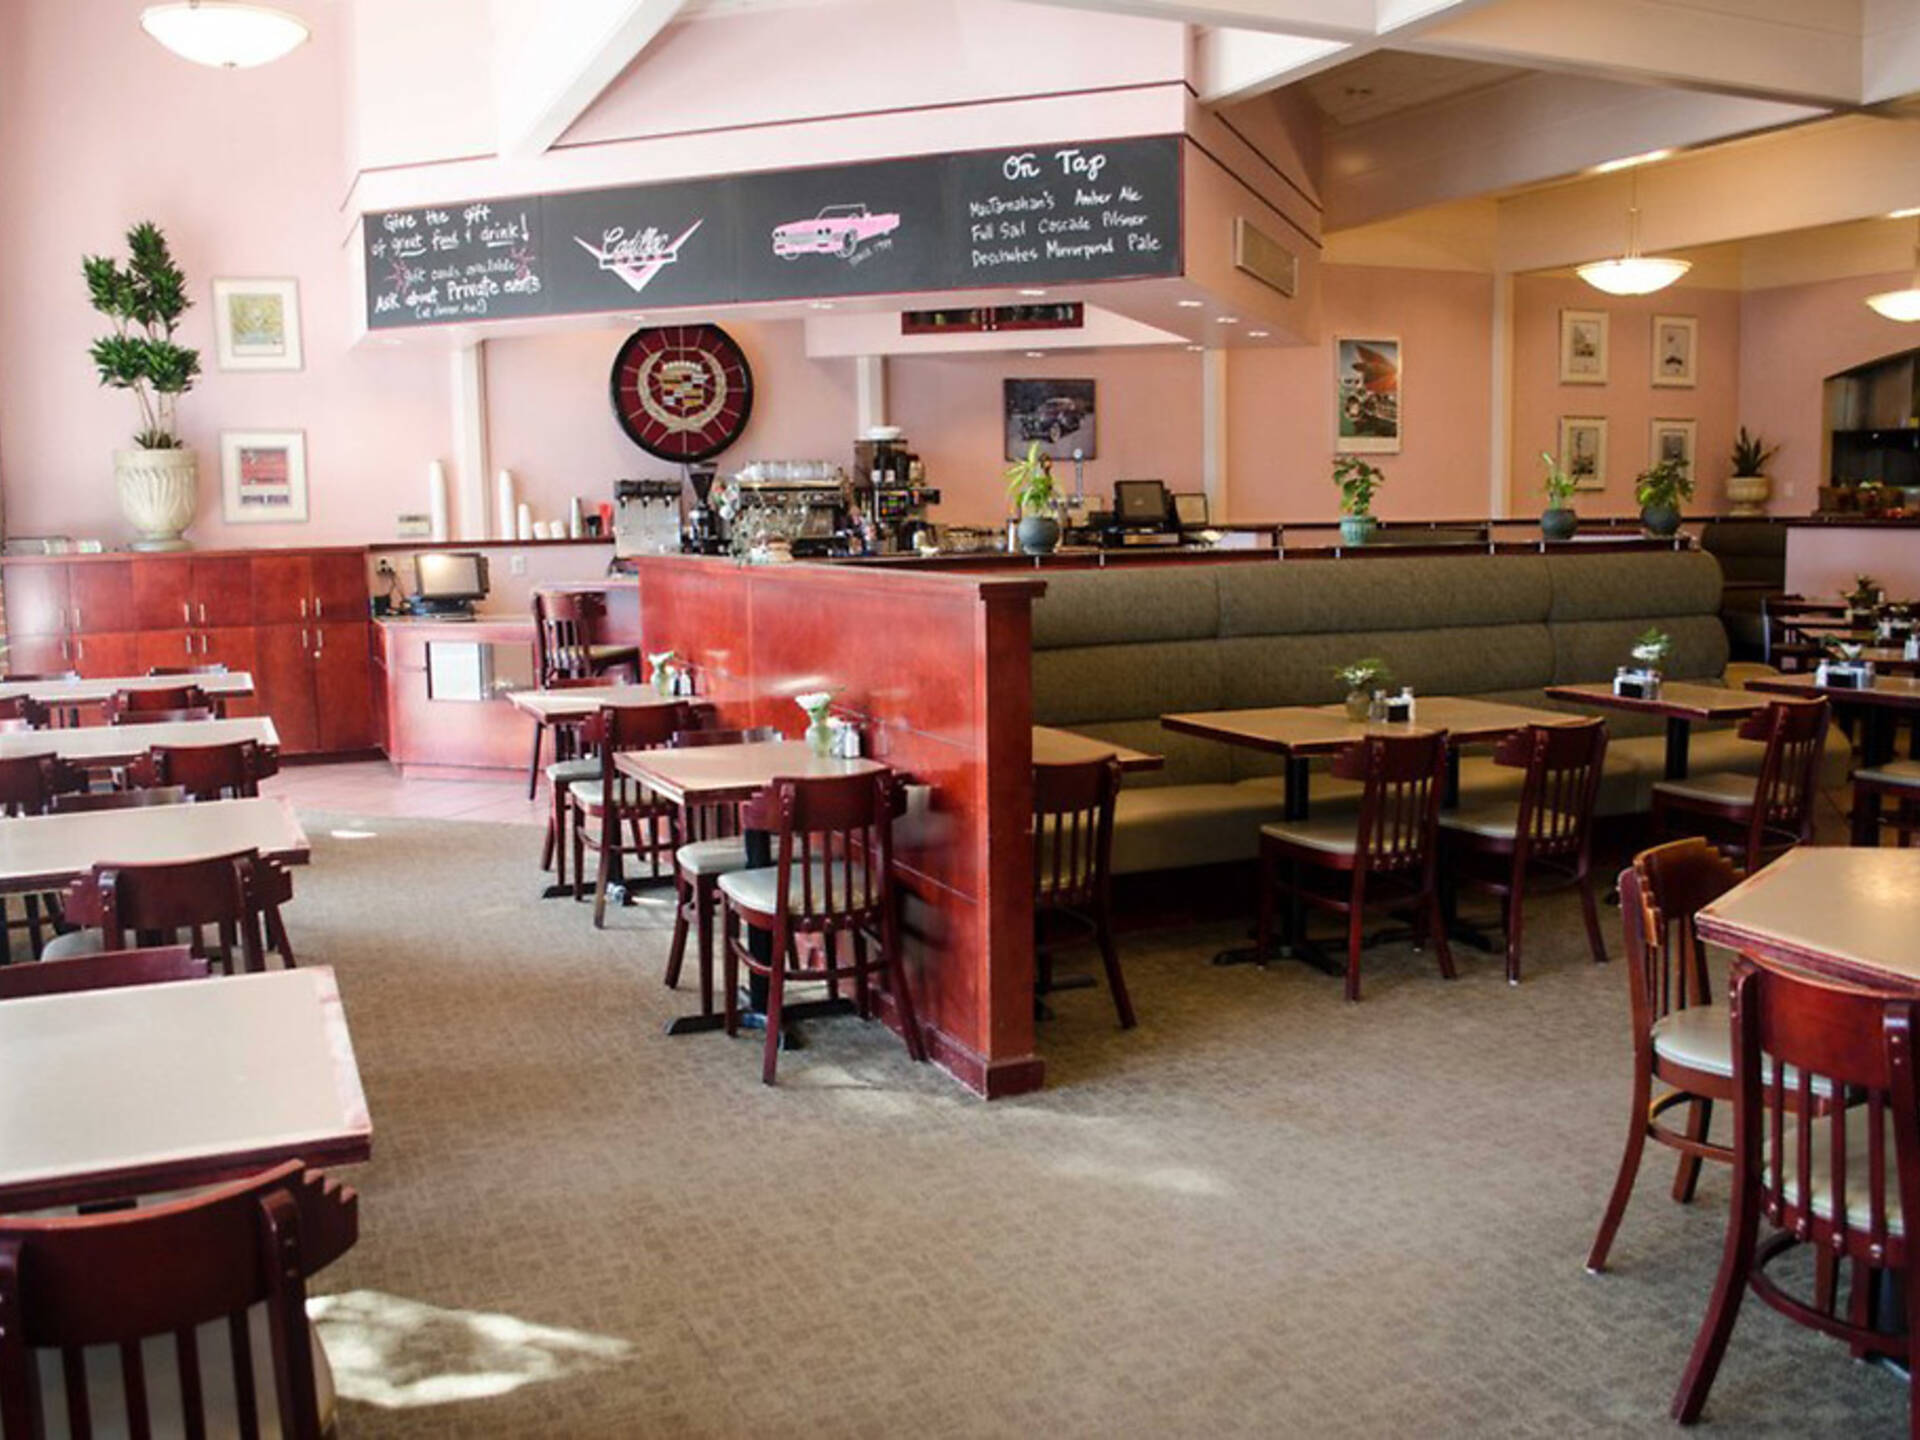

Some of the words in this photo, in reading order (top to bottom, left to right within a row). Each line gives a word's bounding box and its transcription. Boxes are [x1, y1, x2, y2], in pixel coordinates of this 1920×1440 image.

[1003, 154, 1040, 180] On
[1055, 150, 1106, 181] Tap
[1075, 188, 1112, 206] Amber
[1118, 186, 1143, 201] Ale
[383, 213, 417, 233] Give
[426, 210, 450, 226] the
[463, 203, 491, 226] gift
[971, 222, 994, 243] Full
[1038, 217, 1091, 235] Cascade
[1102, 210, 1149, 228] Pilsner
[391, 233, 423, 256] great
[971, 246, 1038, 268] Deschutes
[1127, 232, 1161, 251] Pale
[447, 275, 500, 300] Private
